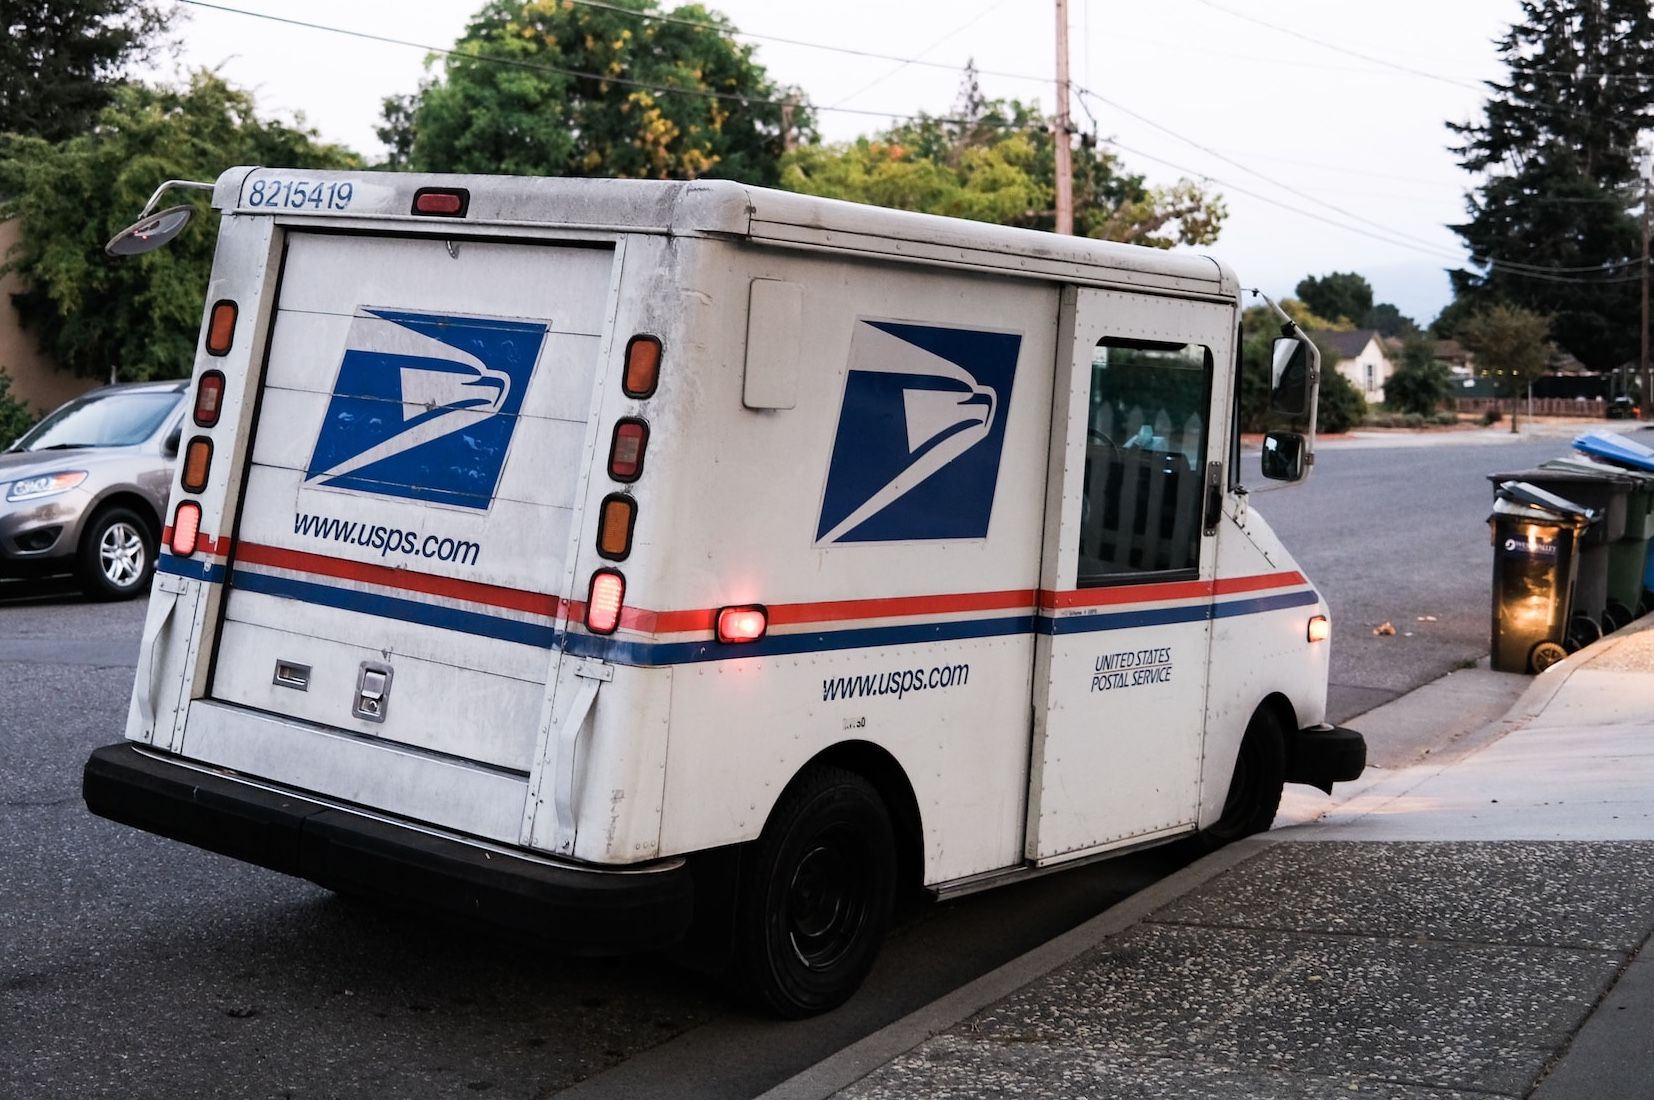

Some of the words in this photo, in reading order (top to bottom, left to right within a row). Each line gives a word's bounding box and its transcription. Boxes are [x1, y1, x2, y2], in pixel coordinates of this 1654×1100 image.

[249, 180, 353, 210] 8215419
[294, 512, 480, 566] www.usps.com
[1095, 651, 1135, 672] UNITED
[1135, 647, 1171, 666] STATES
[823, 663, 969, 701] www.usps.com
[1090, 672, 1130, 693] POSTAL
[1131, 666, 1172, 687] SERVICE
